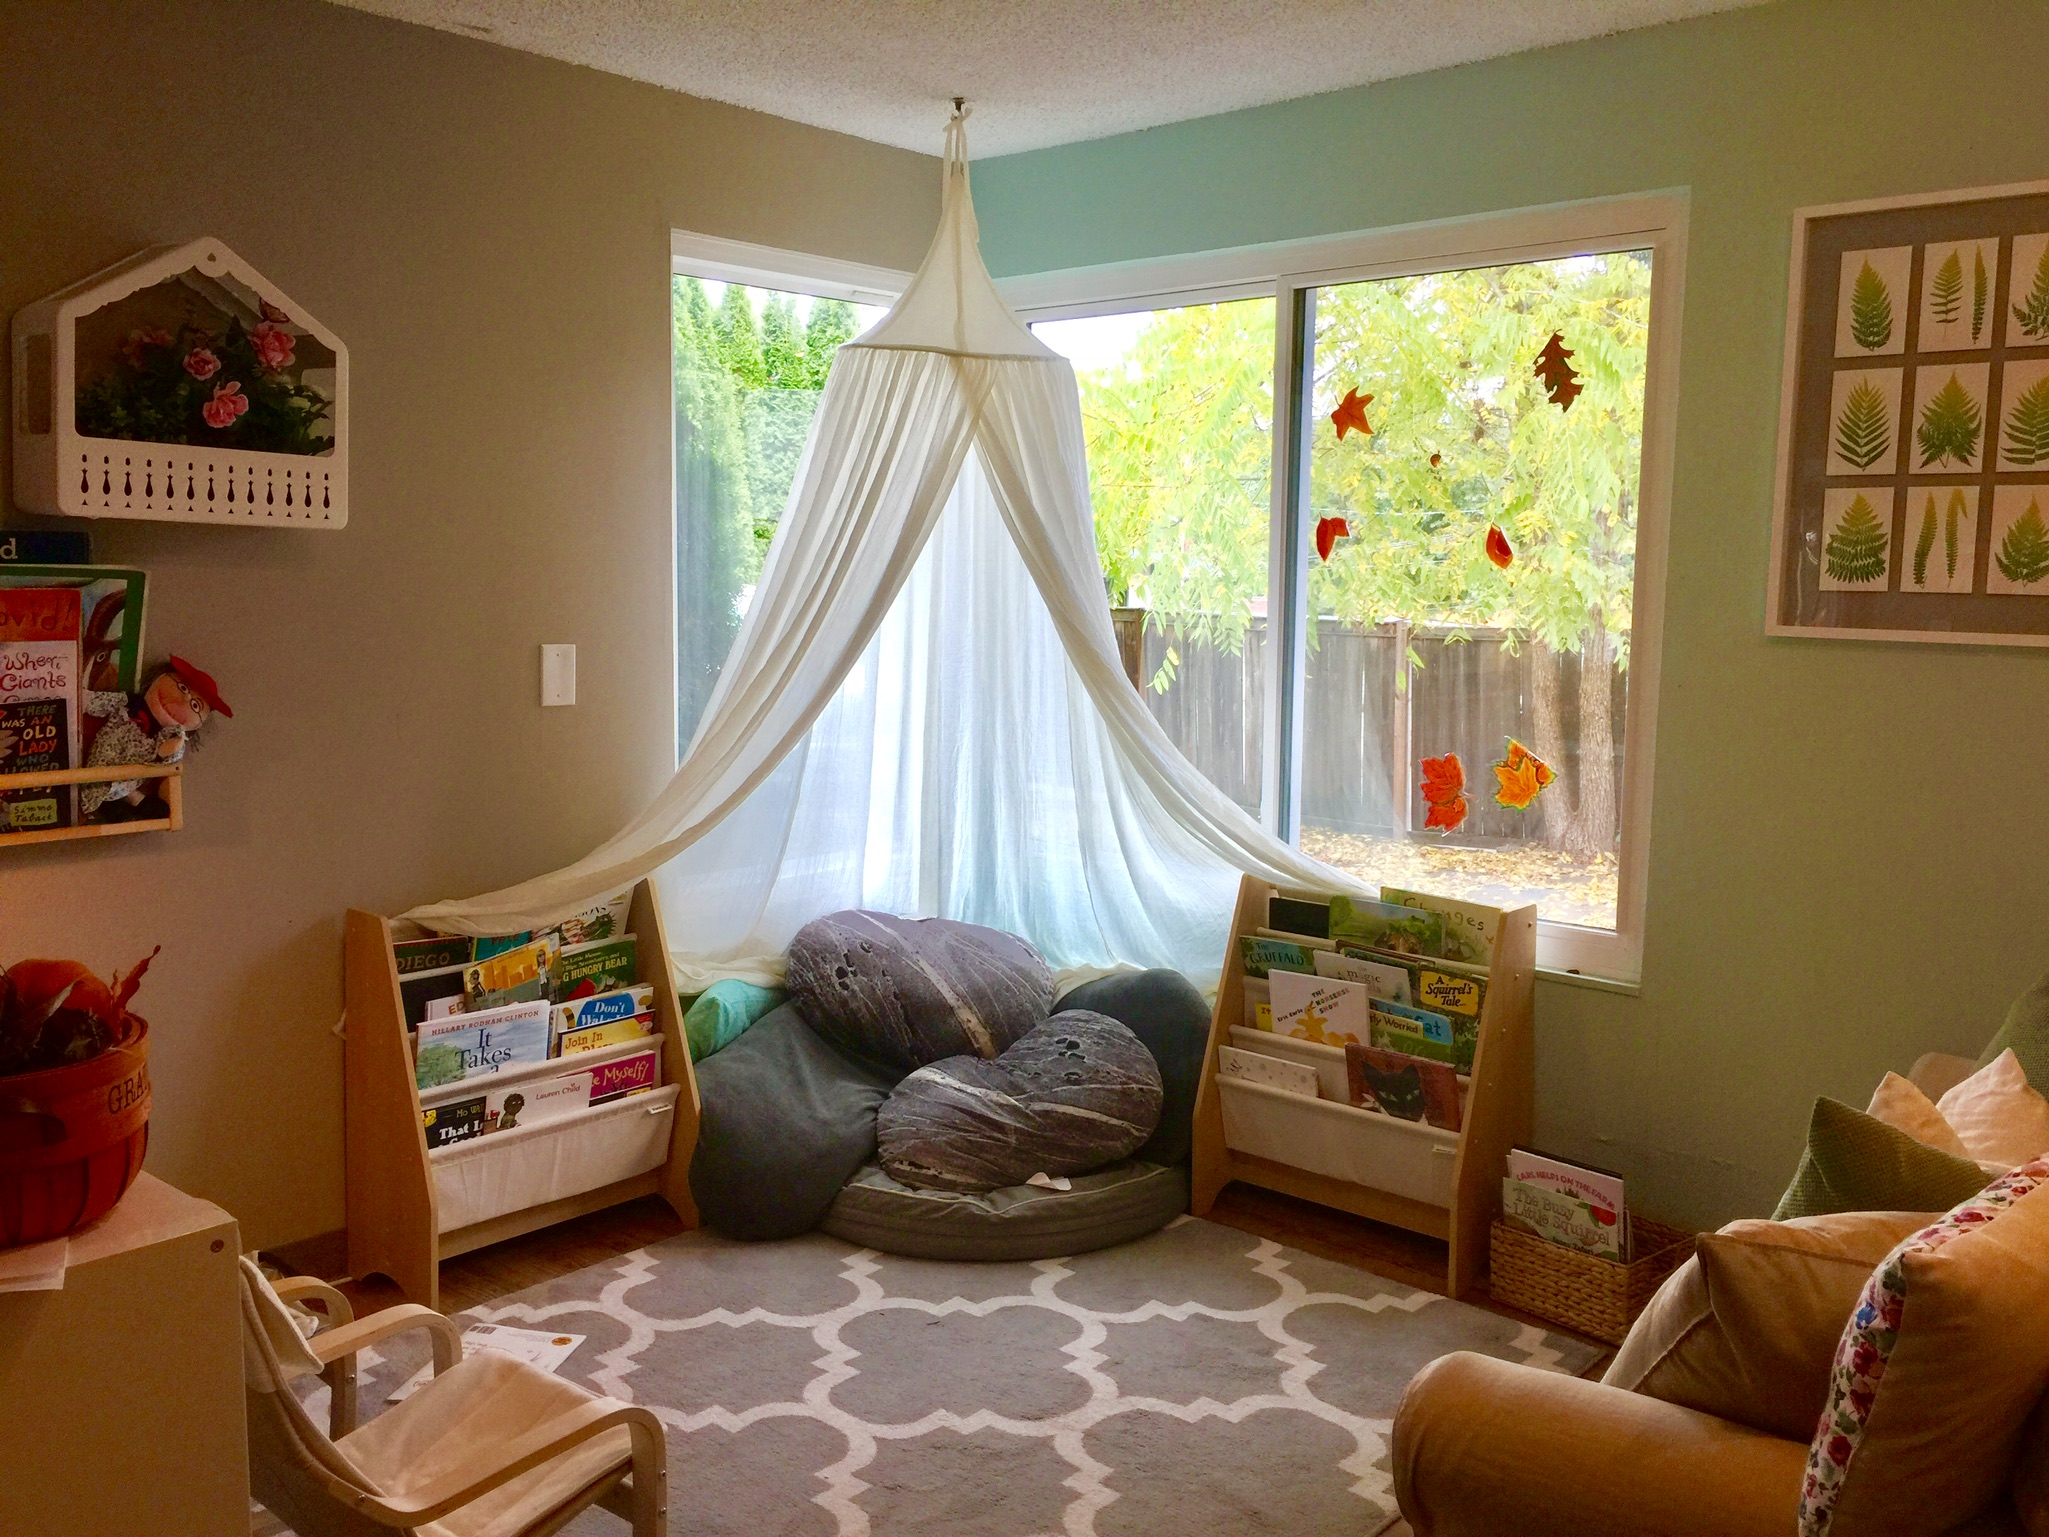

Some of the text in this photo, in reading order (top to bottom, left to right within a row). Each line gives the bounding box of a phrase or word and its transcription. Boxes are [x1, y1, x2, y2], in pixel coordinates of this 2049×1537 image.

[3, 652, 68, 671] When
[0, 671, 67, 692] Giants
[17, 704, 57, 717] THERE
[1, 715, 53, 729] WAS AN
[22, 725, 57, 741] OLD
[19, 738, 58, 757] LADY
[16, 753, 49, 767] WHO
[1249, 951, 1305, 966] GRUFFALO
[571, 962, 604, 981] HUNGRY
[605, 956, 628, 971] BEAR
[1435, 975, 1445, 985] A
[1311, 988, 1326, 998] THE
[1315, 987, 1351, 1006] NONSENSE
[1425, 982, 1474, 999] Squirrel's
[594, 1001, 626, 1013] Don't
[1319, 1001, 1340, 1014] SHOW
[432, 1010, 540, 1036] HILLARY RODHAM CLINTON
[1383, 1015, 1419, 1034] Worried
[476, 1027, 492, 1049] It
[565, 1036, 588, 1050] Join
[592, 1032, 603, 1043] In
[454, 1046, 512, 1070] Takes
[603, 1060, 649, 1086] Myself!
[108, 1066, 147, 1114] GRA
[535, 1084, 581, 1101] Lauren Child
[456, 1108, 469, 1118] Mo
[439, 1122, 470, 1140] That
[1560, 1176, 1574, 1186] ON
[1575, 1180, 1592, 1194] THE
[1513, 1188, 1575, 1222] The Busy
[1513, 1202, 1549, 1227] Little
[1552, 1216, 1610, 1246] Squirrel
